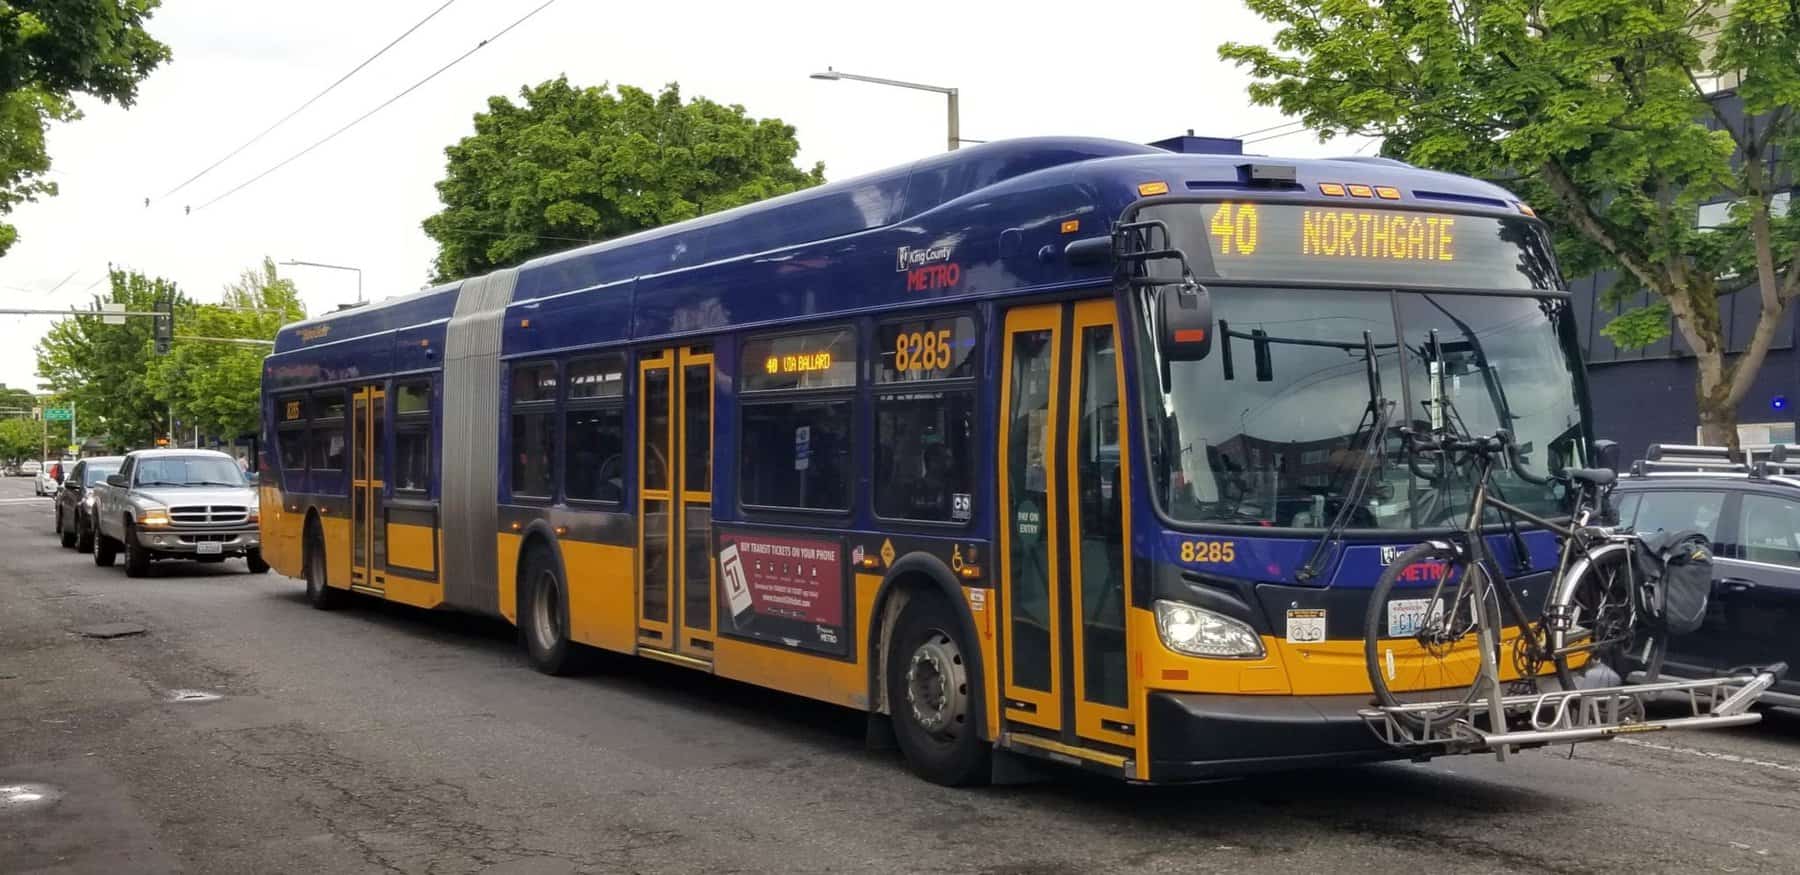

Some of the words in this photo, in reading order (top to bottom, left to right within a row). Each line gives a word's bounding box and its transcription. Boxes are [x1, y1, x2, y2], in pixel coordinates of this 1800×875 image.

[1210, 202, 1257, 255] 40
[1303, 210, 1455, 261] NORTHGATE
[910, 249, 926, 265] King
[926, 246, 952, 262] County
[907, 263, 960, 292] METRO
[896, 330, 951, 372] 8285
[766, 357, 779, 374] 40
[783, 355, 798, 372] VIA
[798, 352, 831, 371] BALLARD
[1017, 511, 1029, 521] PAY
[1029, 511, 1039, 521] ON
[1019, 523, 1038, 534] ENTRY
[740, 542, 750, 552] BUY
[751, 543, 771, 555] TRANSIT
[772, 545, 791, 557] TICKETS
[791, 547, 801, 558] ON
[801, 548, 815, 560] YOUR
[816, 549, 836, 562] PHONE
[1181, 541, 1235, 562] 8285
